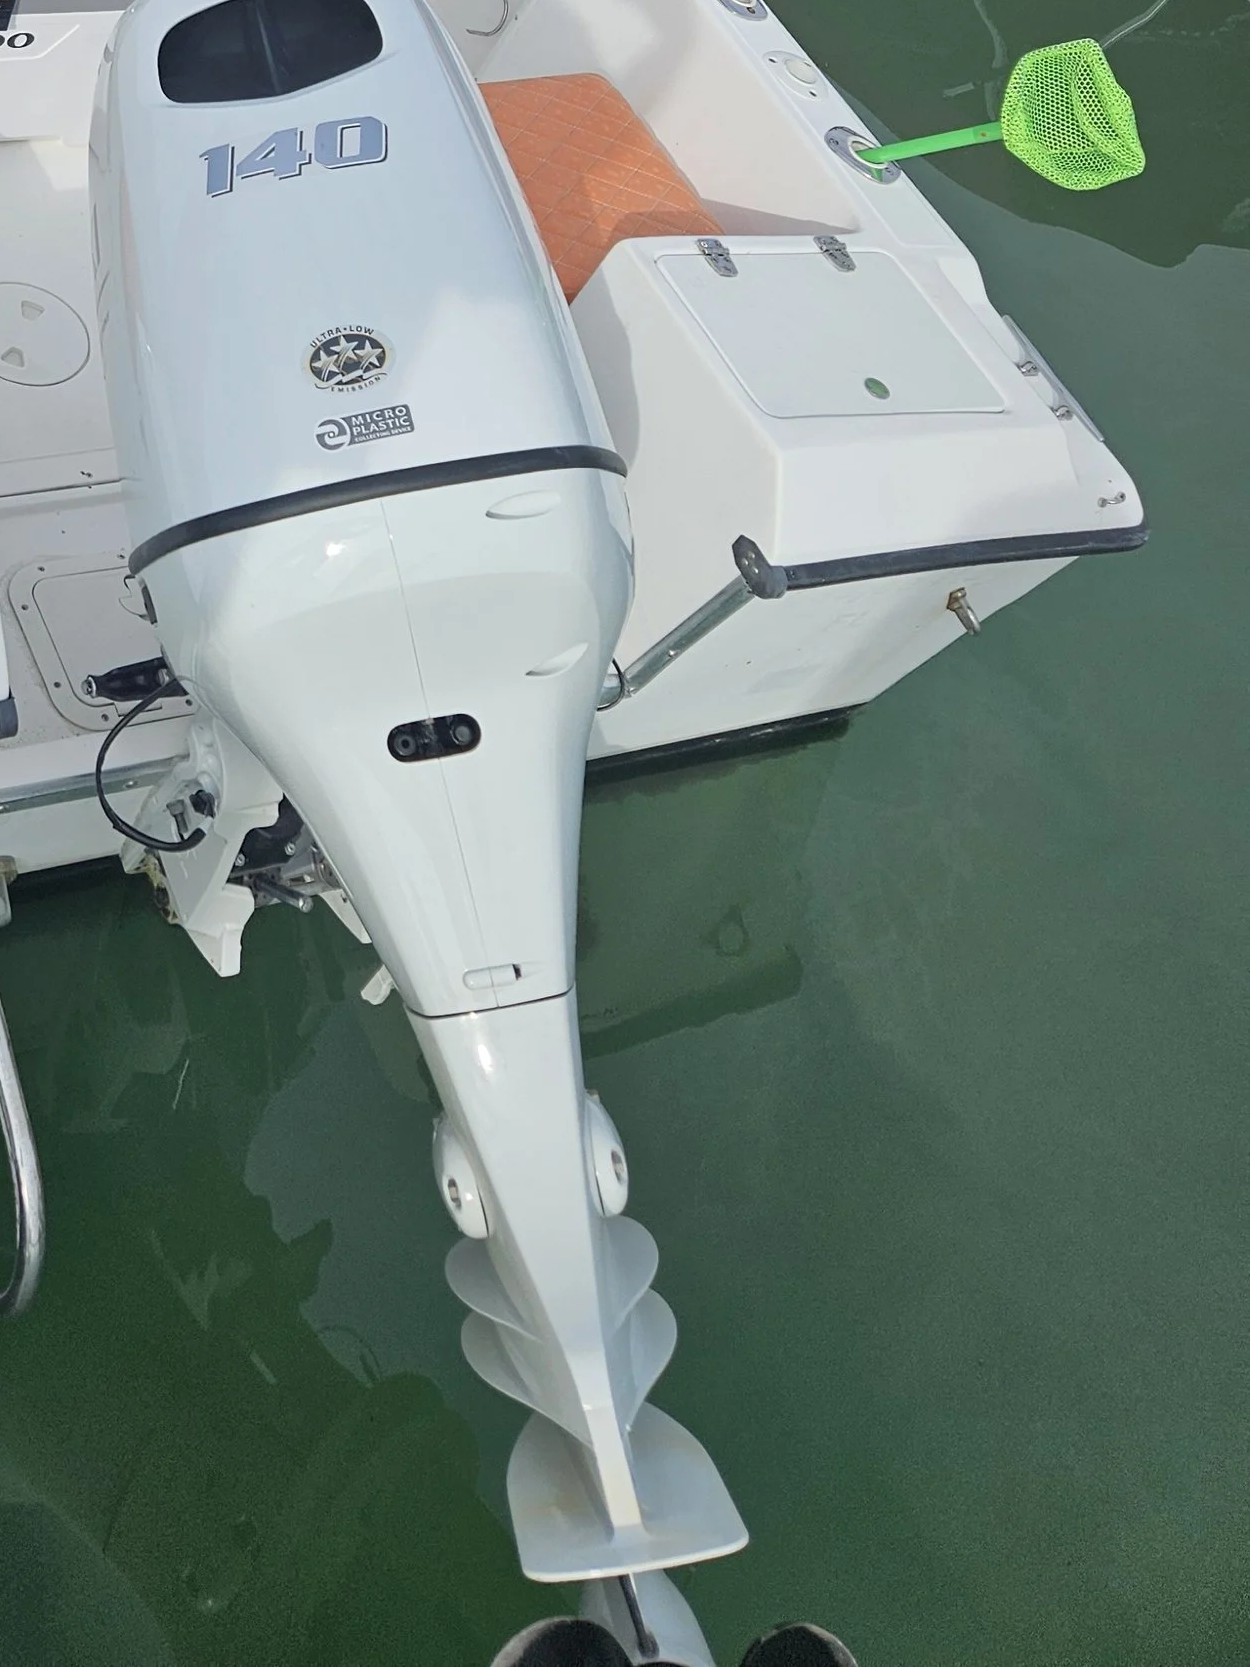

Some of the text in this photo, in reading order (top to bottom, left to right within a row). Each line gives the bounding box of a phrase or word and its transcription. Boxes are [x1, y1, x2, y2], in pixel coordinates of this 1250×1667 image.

[199, 116, 388, 198] 140
[310, 325, 374, 348] ULTRA LOW
[331, 376, 381, 392] EMISSION
[351, 407, 406, 426] MICRO
[352, 416, 410, 436] PLASTIC
[391, 426, 411, 435] DEVICE
